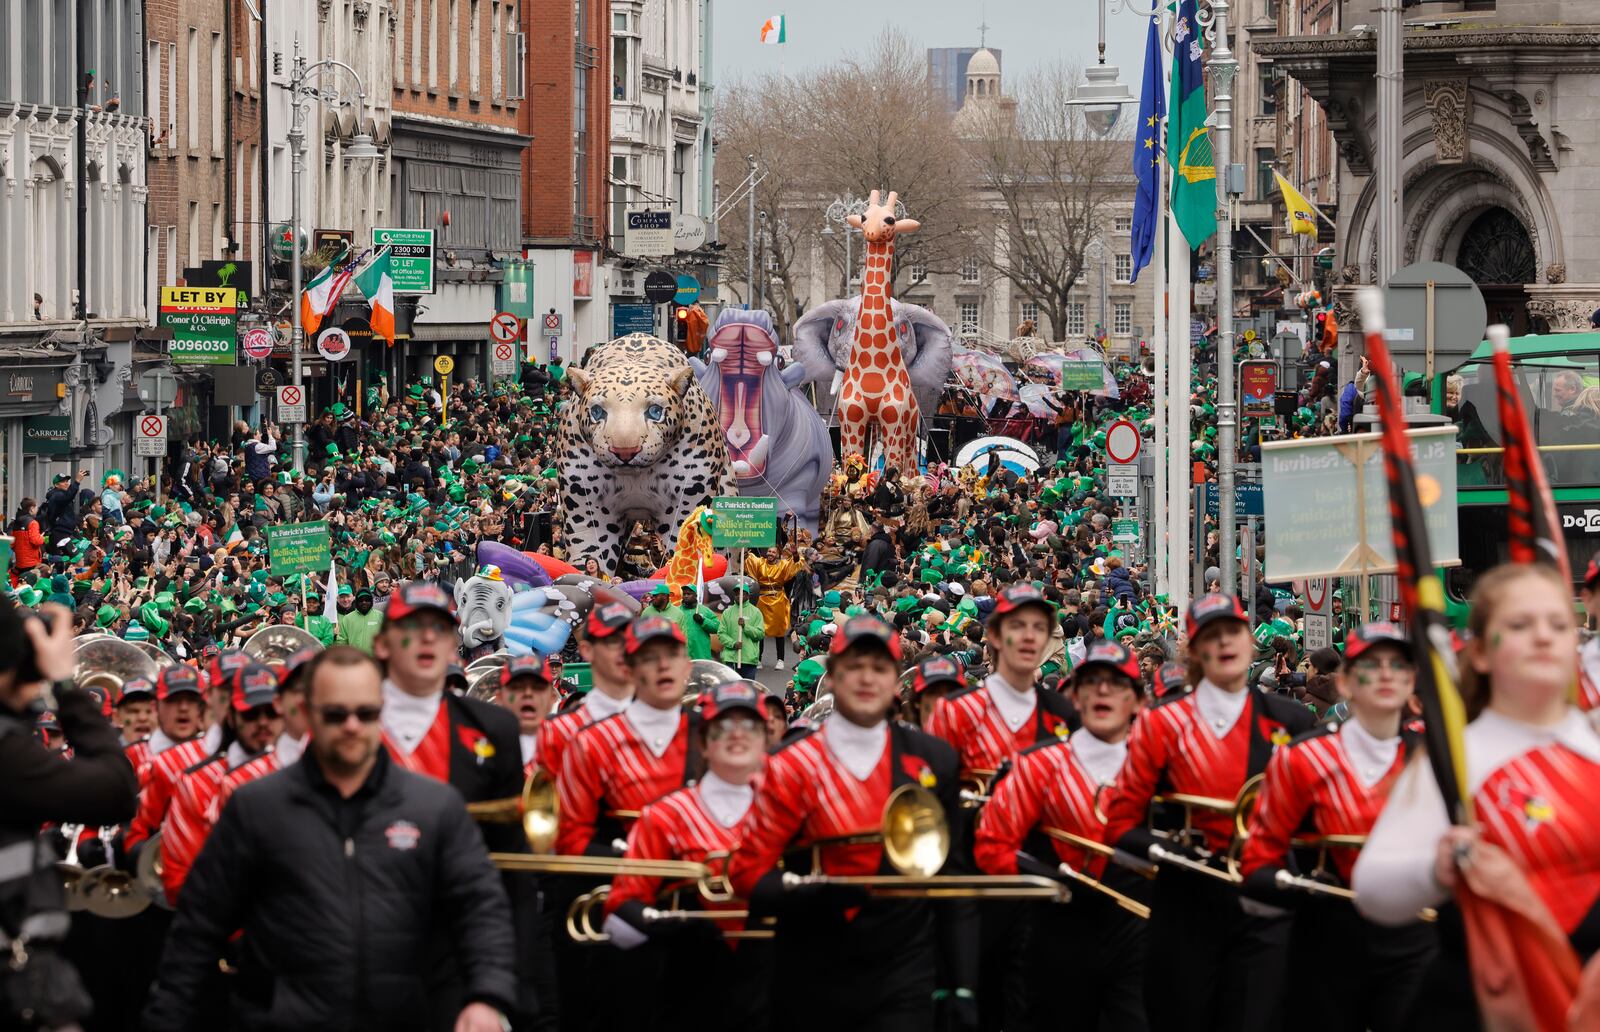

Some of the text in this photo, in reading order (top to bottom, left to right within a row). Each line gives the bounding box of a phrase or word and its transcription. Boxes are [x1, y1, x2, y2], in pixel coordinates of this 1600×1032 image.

[631, 215, 668, 226] COMPANY
[171, 292, 227, 304] LET BY
[166, 313, 231, 326] Conor Ó Cléirigh
[27, 427, 68, 437] CARROLLS
[724, 501, 751, 509] Patrick's
[744, 520, 773, 529] Parade
[279, 528, 304, 536] Patrick's
[304, 525, 326, 534] Festival
[723, 529, 765, 538] Adventure
[299, 544, 327, 555] Parade
[281, 554, 320, 565] Adventure
